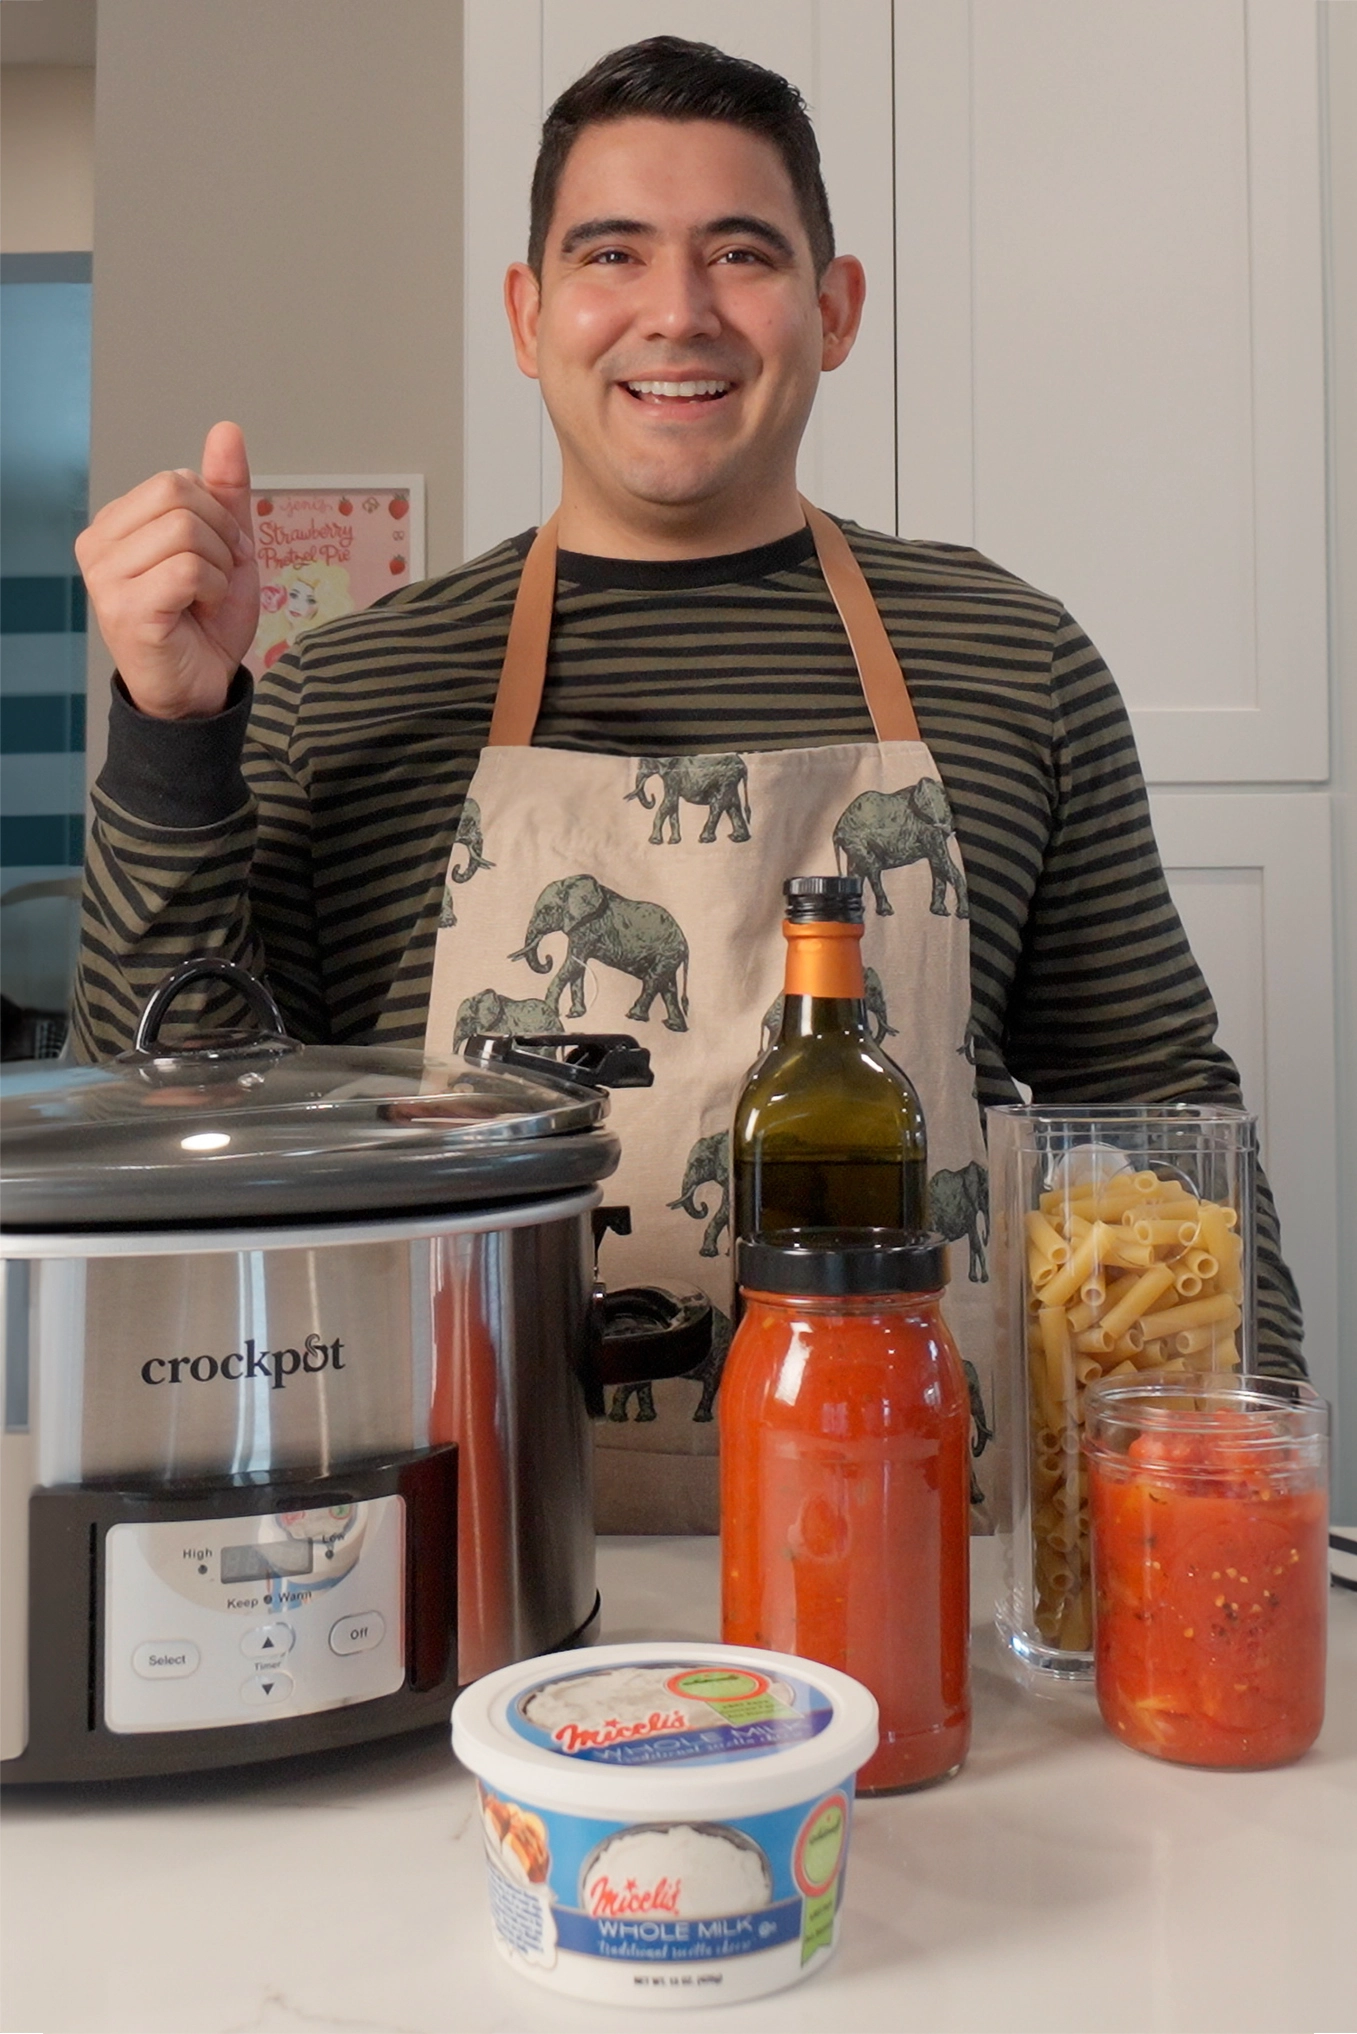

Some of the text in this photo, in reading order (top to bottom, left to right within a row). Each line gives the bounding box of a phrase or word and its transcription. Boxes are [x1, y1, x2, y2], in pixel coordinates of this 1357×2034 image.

[259, 518, 354, 548] Strawberry
[258, 544, 351, 570] Pretzel Pie
[141, 1333, 346, 1390] crockpot
[322, 1532, 345, 1544] Low
[182, 1548, 213, 1560] High
[227, 1589, 312, 1610] Keep Warm
[350, 1626, 369, 1641] Off
[149, 1654, 186, 1667] Select
[254, 1660, 282, 1672] Timer
[593, 1731, 723, 1760] WHOLE
[599, 1919, 690, 1942] WHOLE
[698, 1915, 753, 1939] MILK
